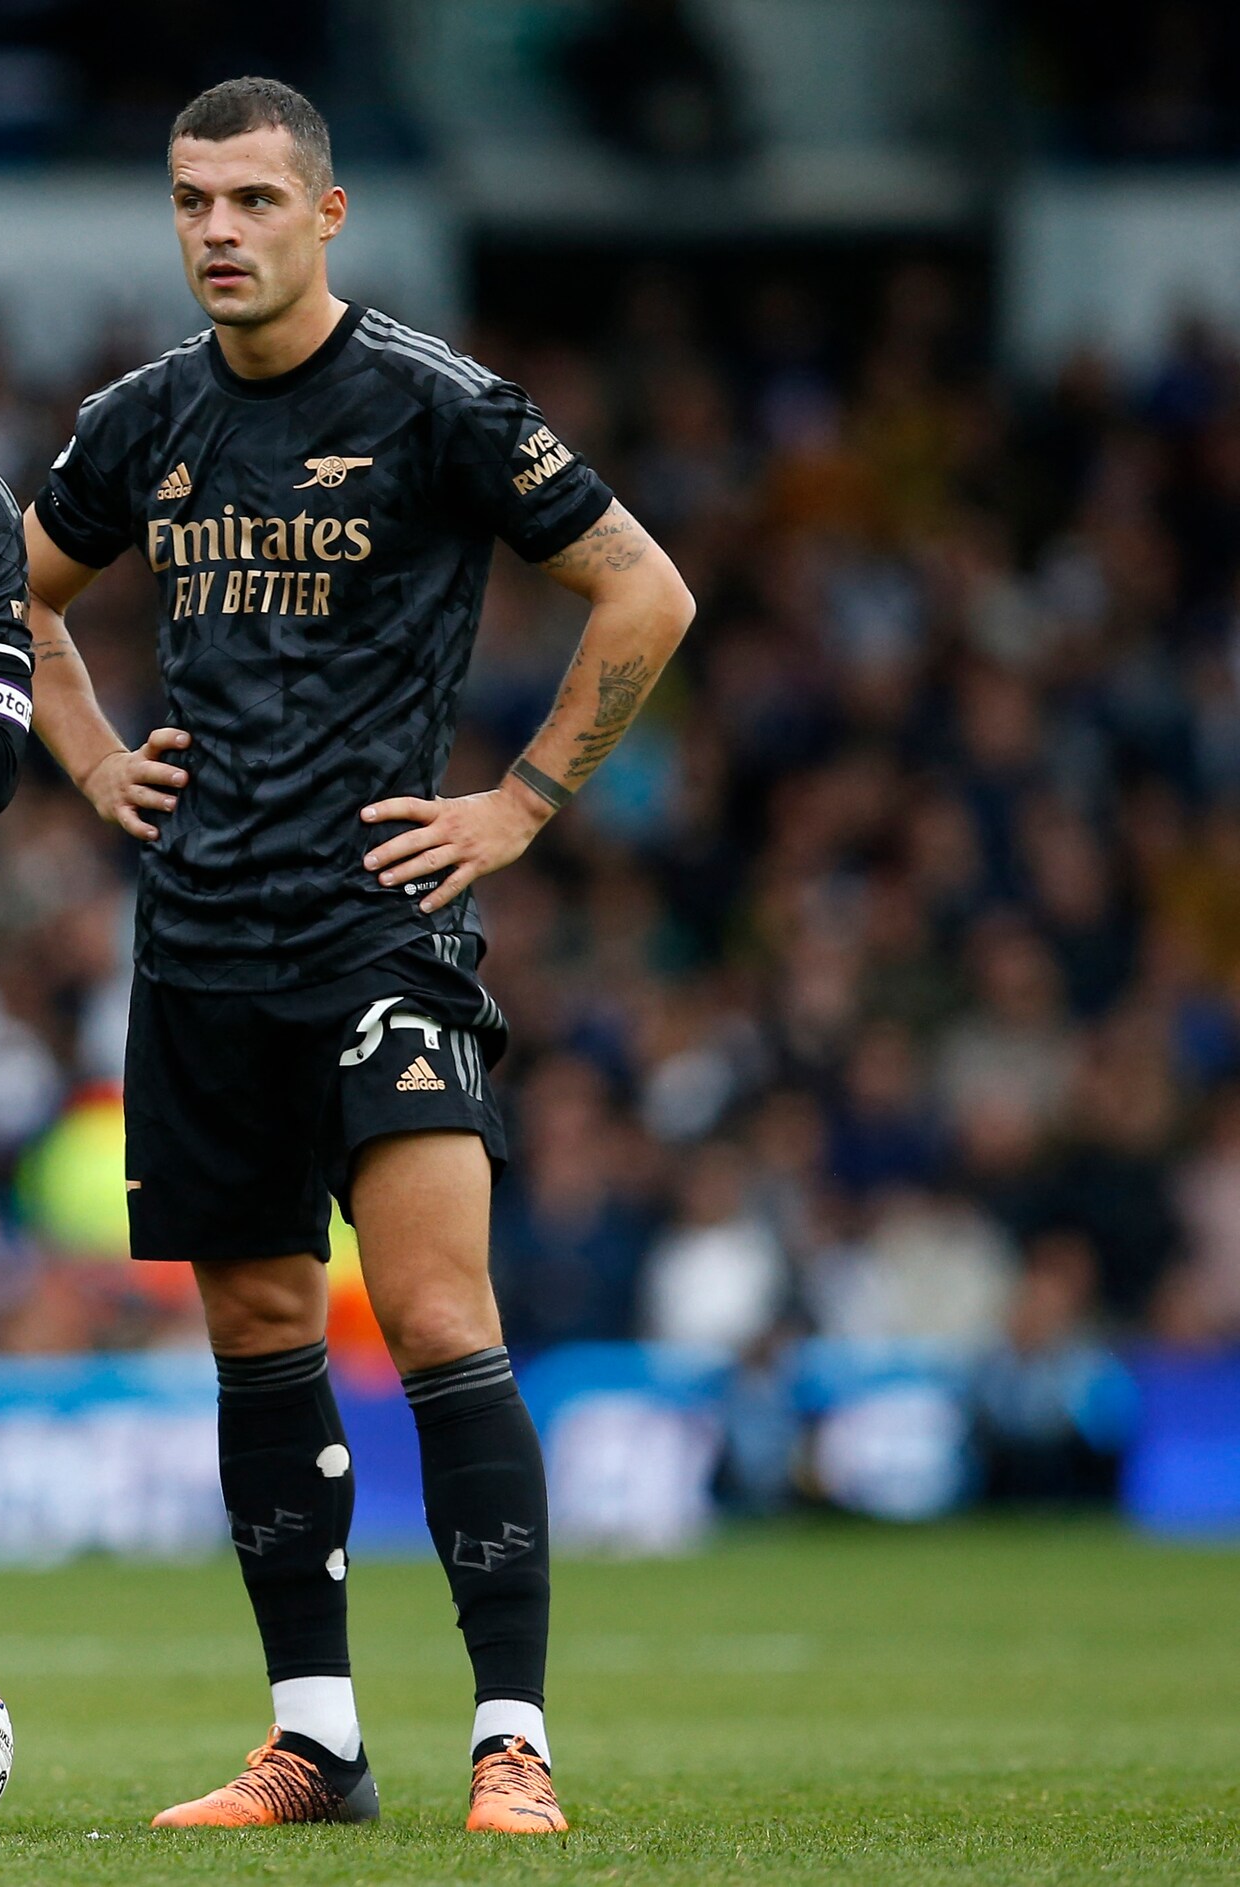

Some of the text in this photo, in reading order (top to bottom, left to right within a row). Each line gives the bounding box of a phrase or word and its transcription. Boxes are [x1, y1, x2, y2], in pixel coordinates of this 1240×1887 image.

[157, 484, 192, 500] adidas
[147, 503, 372, 573] Emirates
[172, 570, 331, 621] FLY BETTER
[396, 1078, 446, 1092] adidas
